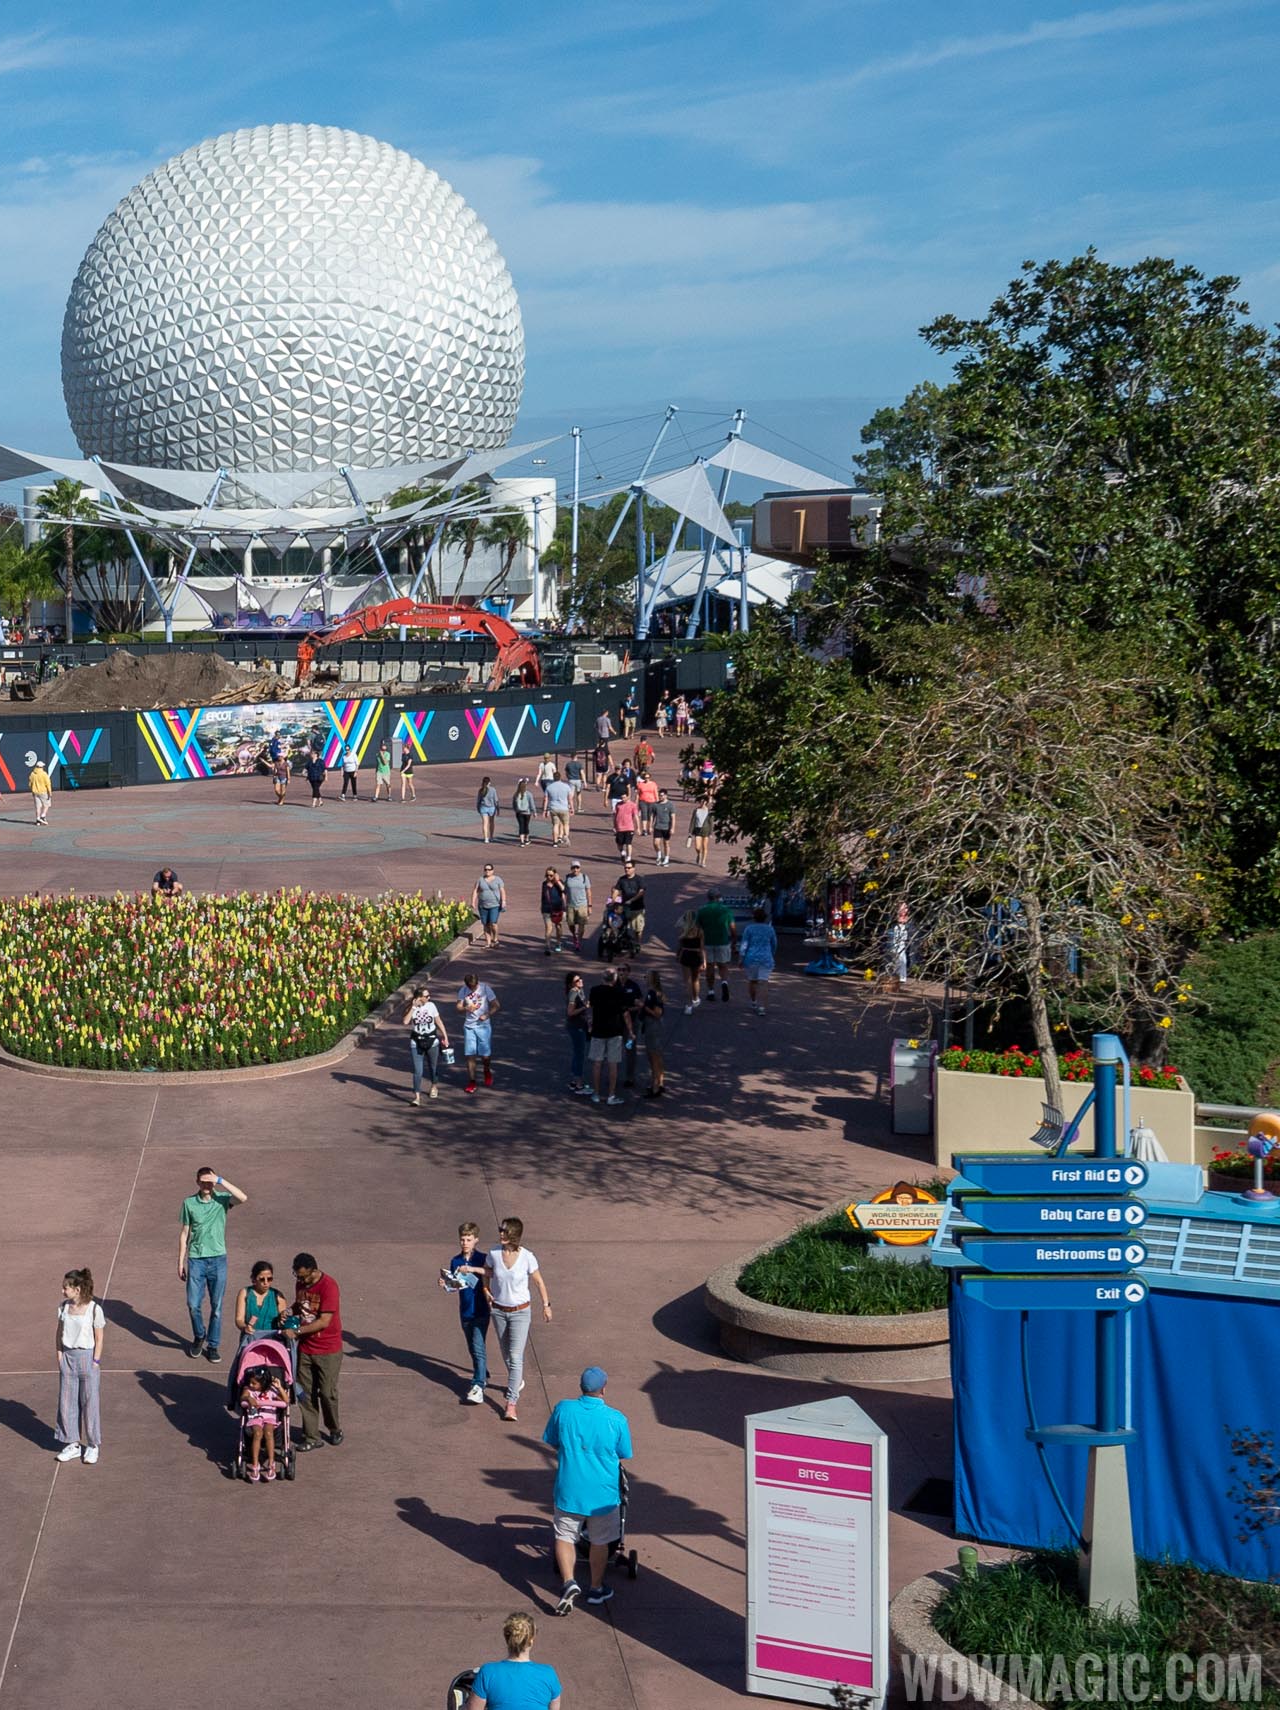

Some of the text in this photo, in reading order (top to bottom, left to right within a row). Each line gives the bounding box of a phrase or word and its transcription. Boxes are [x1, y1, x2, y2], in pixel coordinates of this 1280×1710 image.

[206, 710, 232, 721] EPCOT
[1052, 1170, 1105, 1181] First Aid
[1040, 1209, 1105, 1222] Baby Care
[1036, 1249, 1105, 1260] Restrooms
[1096, 1288, 1121, 1299] Exit
[798, 1468, 829, 1481] BITES
